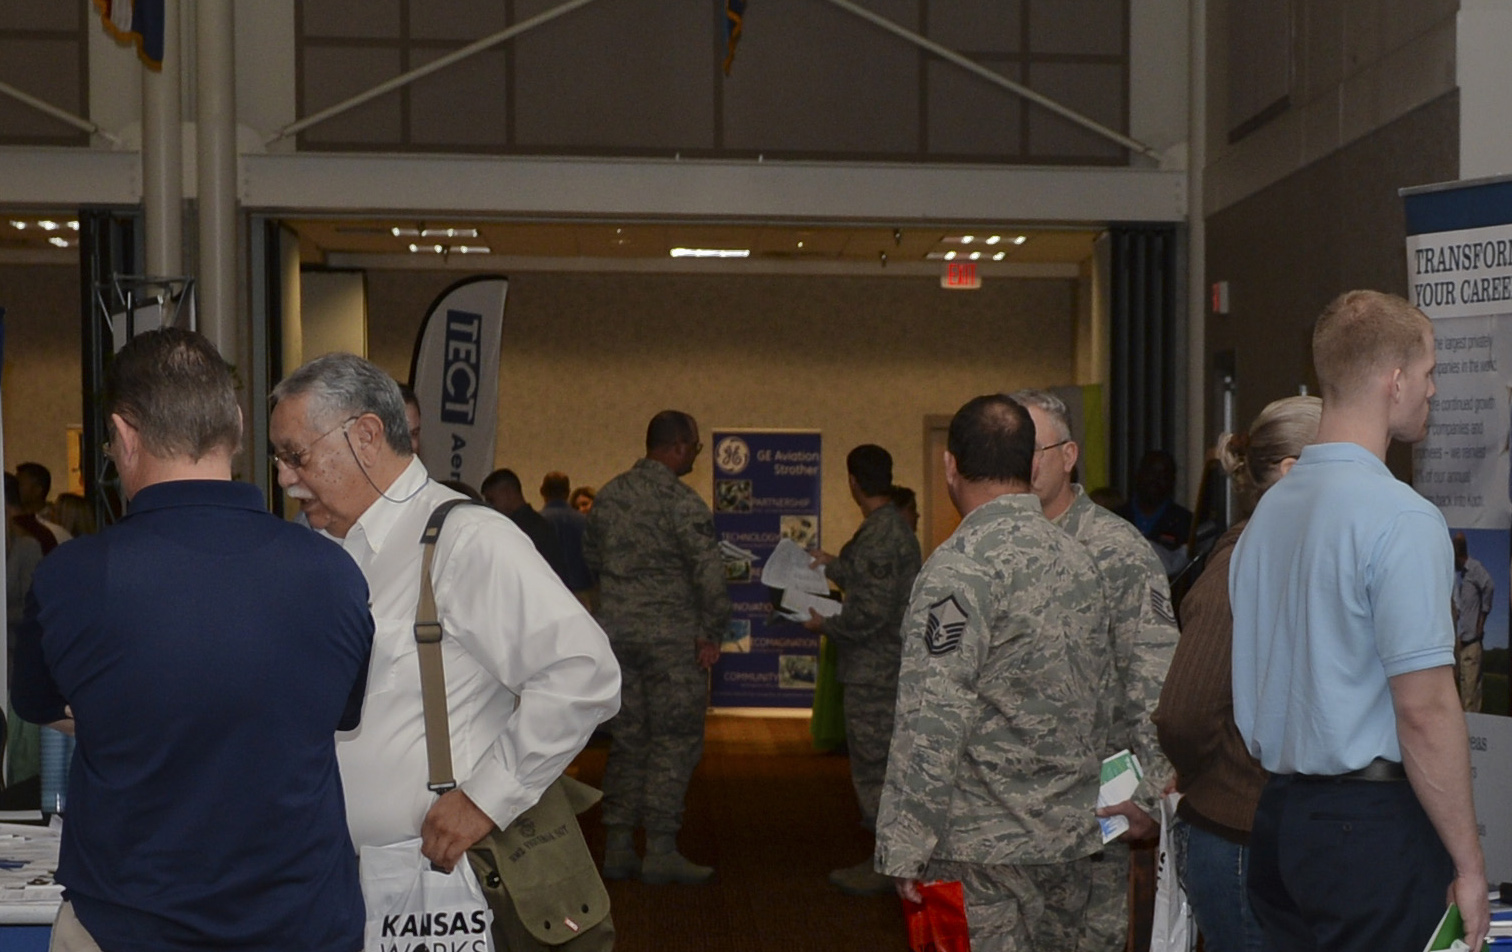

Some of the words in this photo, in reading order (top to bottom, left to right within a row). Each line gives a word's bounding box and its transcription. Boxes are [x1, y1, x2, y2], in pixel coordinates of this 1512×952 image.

[947, 262, 977, 287] EXIT
[1414, 281, 1456, 308] YOUR
[445, 318, 479, 423] TECT
[756, 449, 772, 462] GE
[774, 449, 820, 462] Aviation
[381, 910, 487, 938] KANSAS
